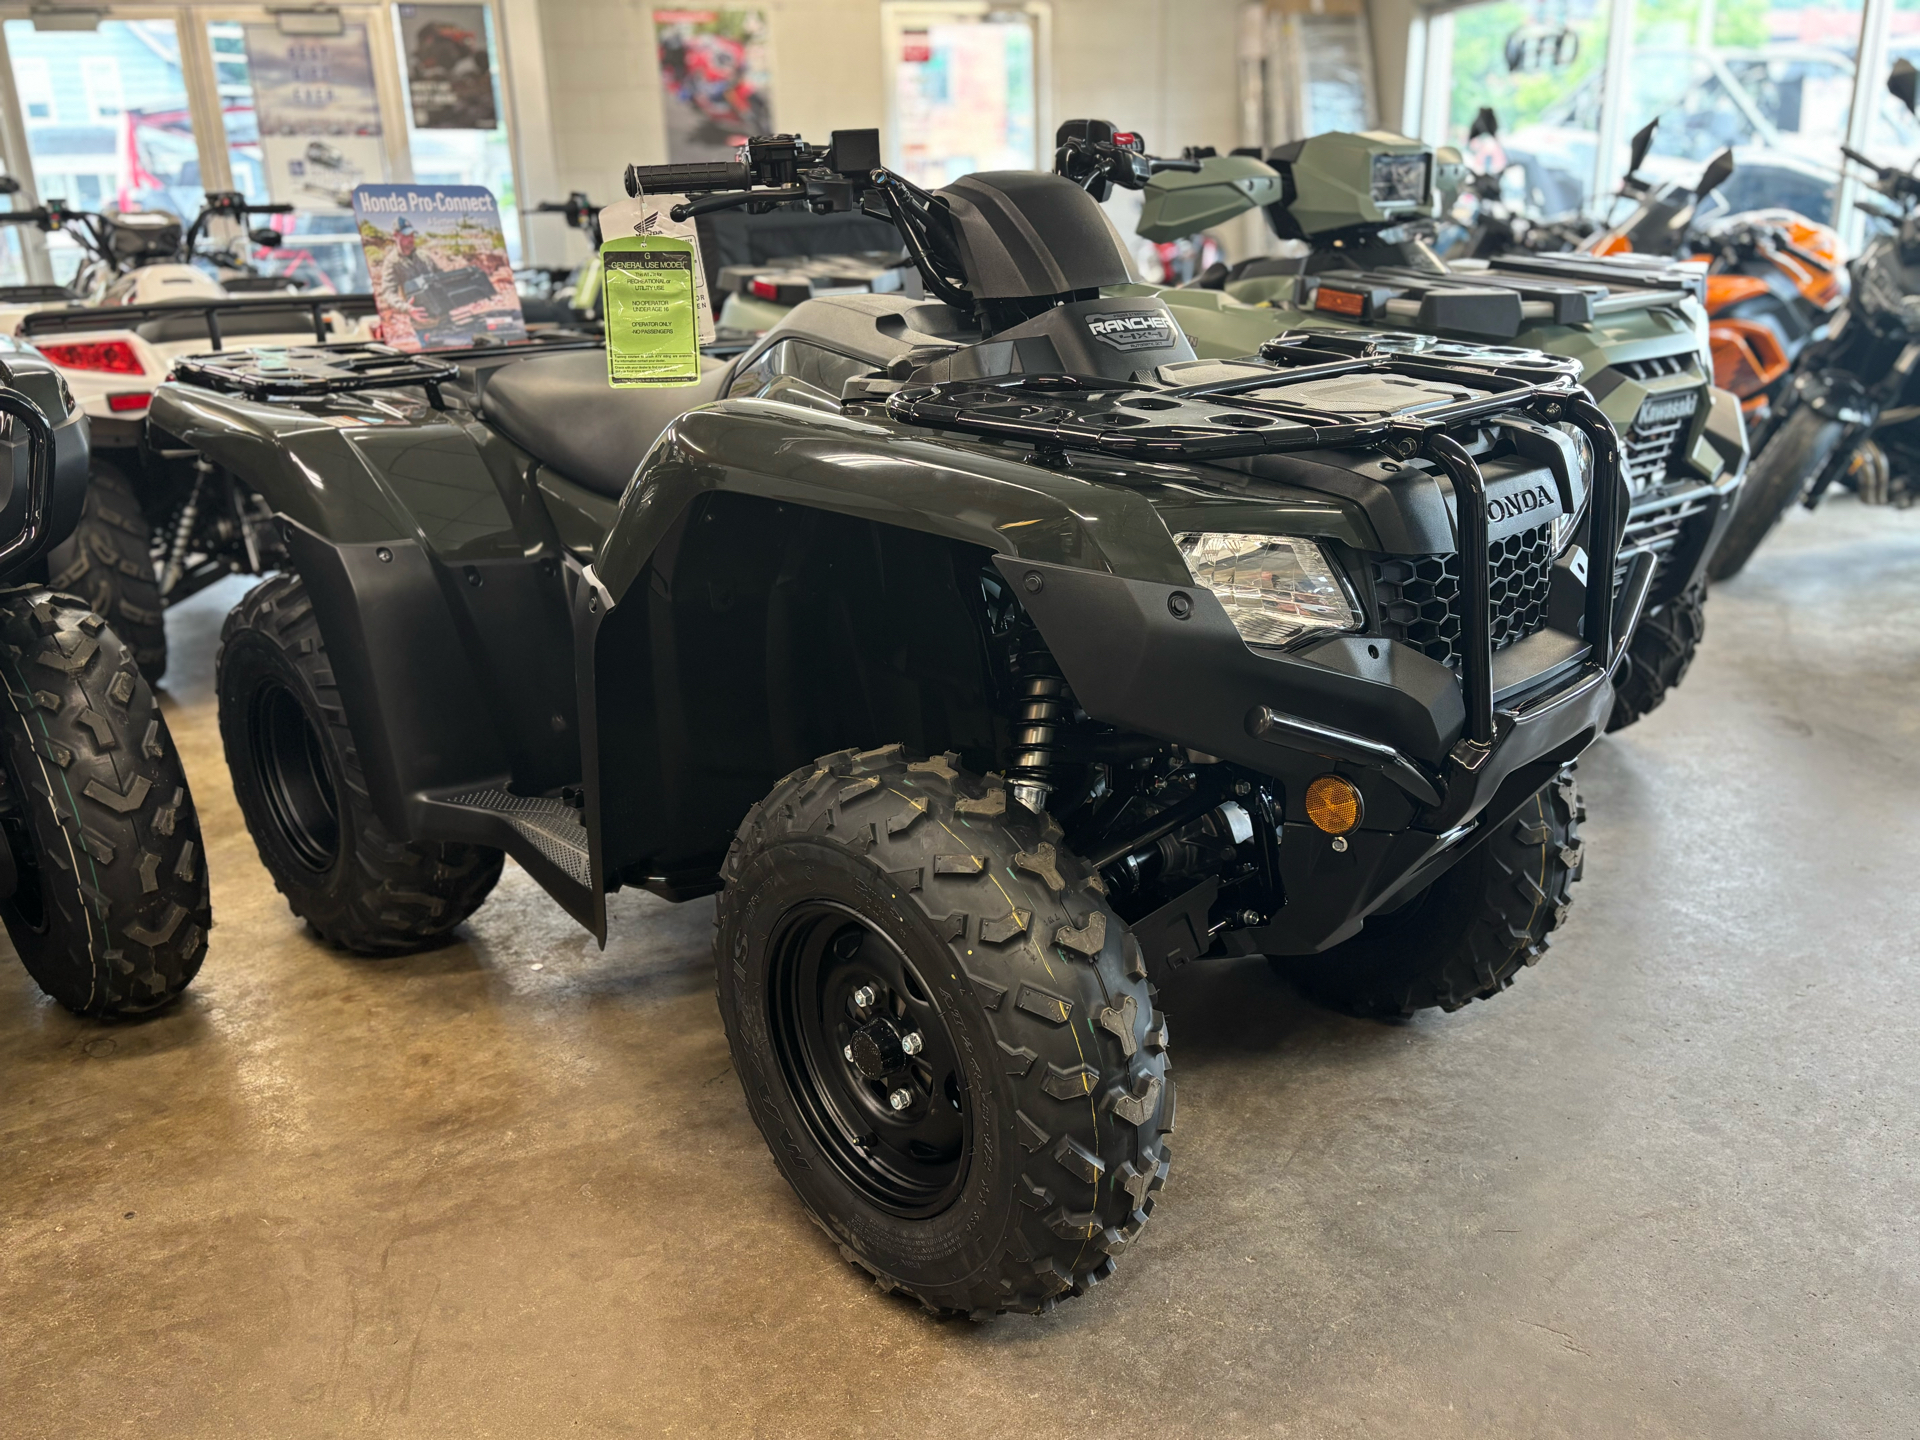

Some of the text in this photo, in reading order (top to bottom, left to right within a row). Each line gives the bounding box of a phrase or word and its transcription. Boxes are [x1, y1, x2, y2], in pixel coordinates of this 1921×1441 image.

[359, 192, 494, 212] Honda Pro-Connect
[611, 261, 684, 269] GENERAL USE MODEL
[644, 252, 651, 260] G
[1088, 317, 1171, 336] RANCHER
[1638, 393, 1698, 425] Kawasaki
[1487, 485, 1555, 523] ONDA
